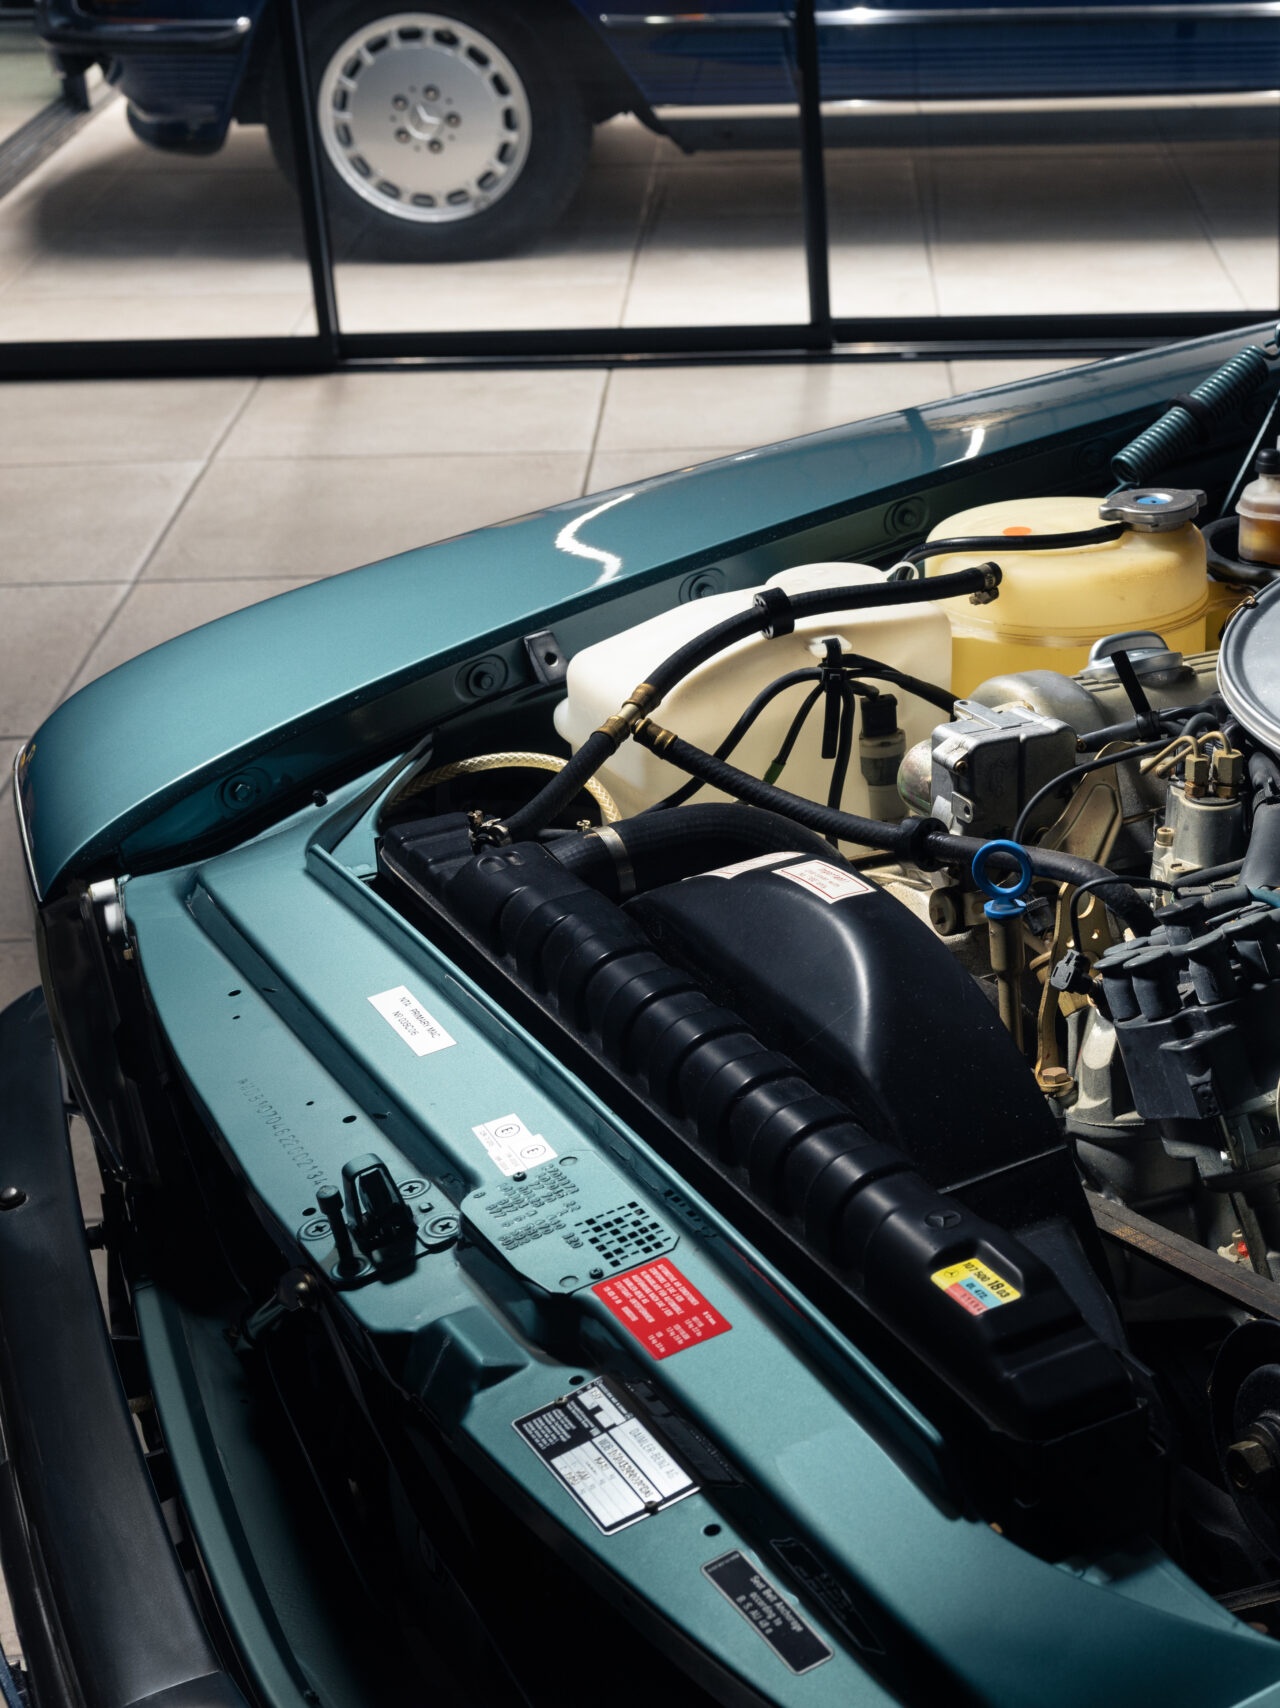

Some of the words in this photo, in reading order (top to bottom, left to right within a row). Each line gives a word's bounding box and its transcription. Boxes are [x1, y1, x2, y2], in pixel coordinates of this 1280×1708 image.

[409, 1009, 430, 1026] PRIMARY
[988, 1280, 1004, 1290] 18
[629, 1428, 669, 1468] DAIMLER-BENZ
[746, 1591, 777, 1619] according
[748, 1575, 766, 1590] Seat
[761, 1588, 777, 1602] Belt
[770, 1601, 806, 1633] Anchorage
